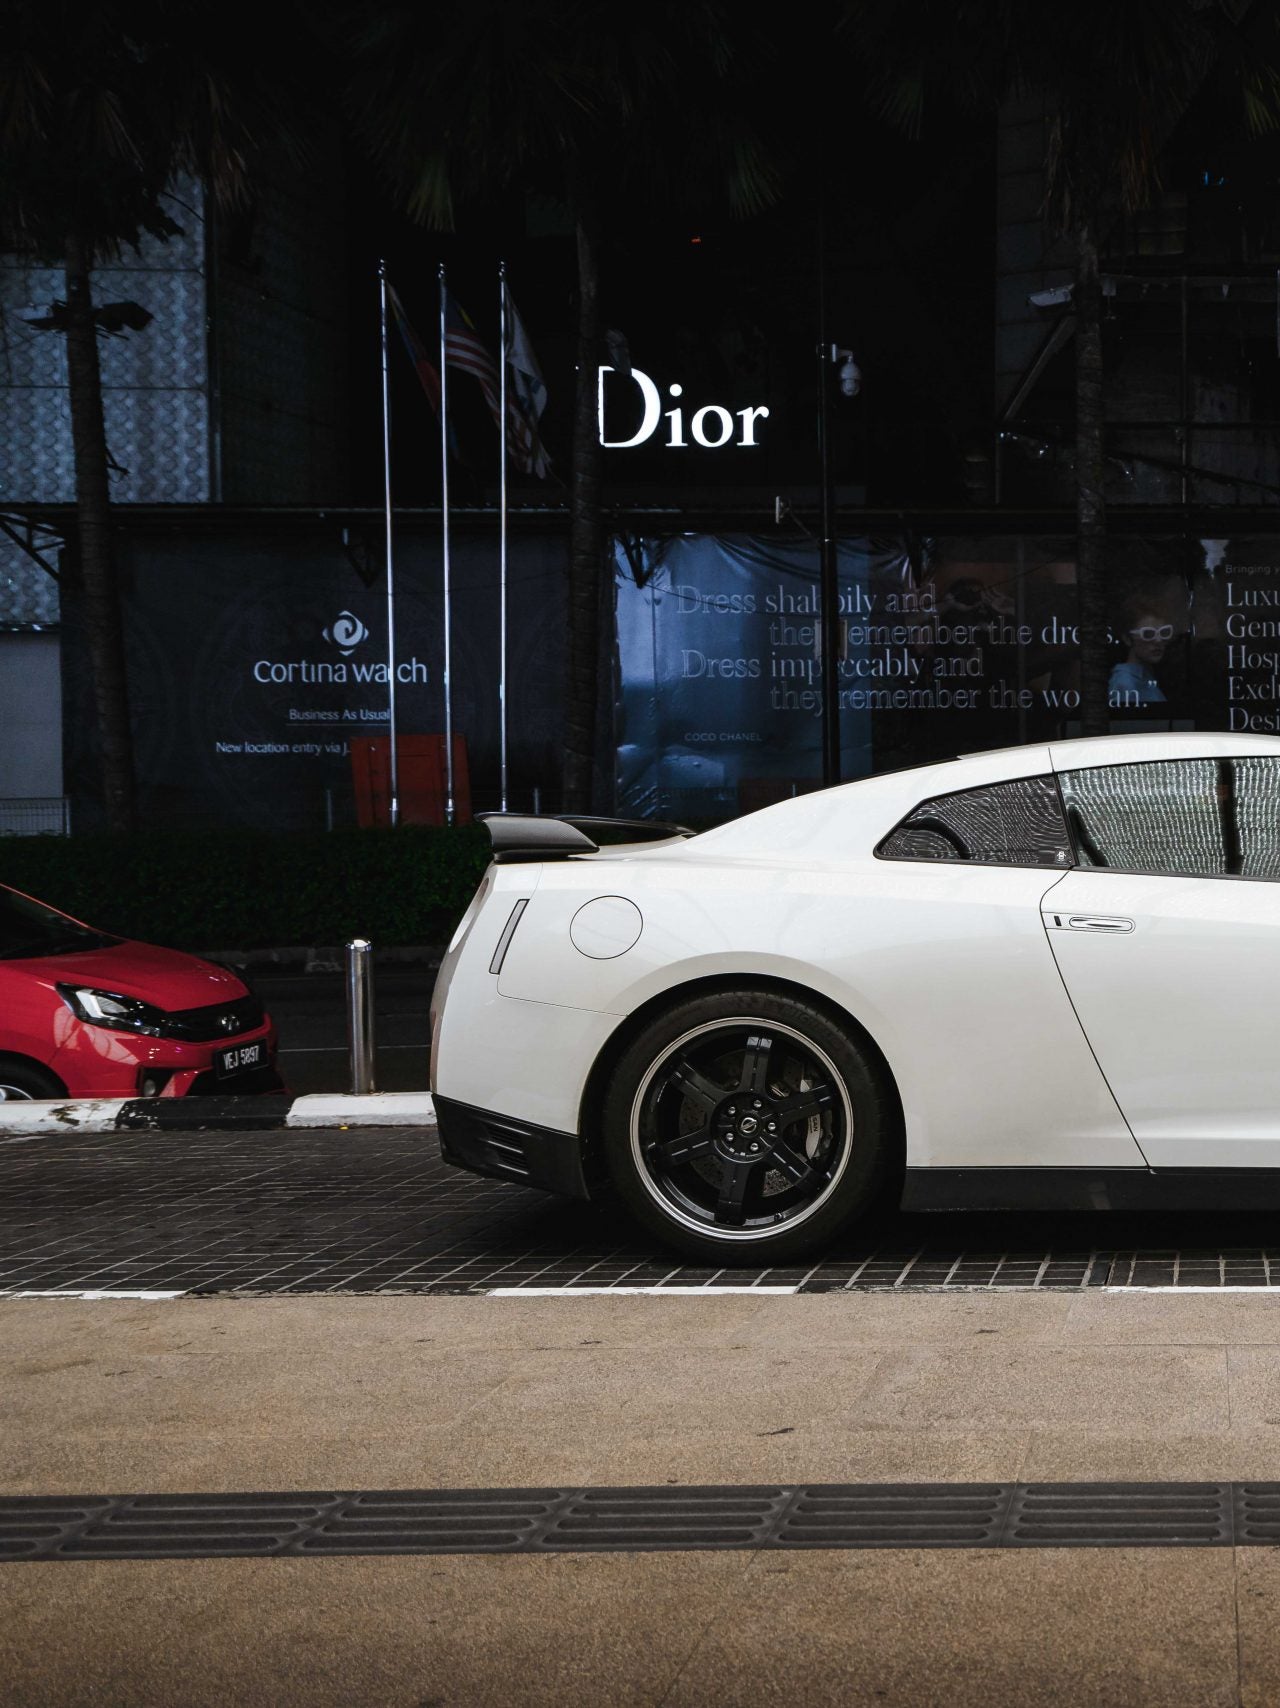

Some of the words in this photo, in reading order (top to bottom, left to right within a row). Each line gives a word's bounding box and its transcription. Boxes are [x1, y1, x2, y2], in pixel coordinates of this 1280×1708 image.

[598, 365, 769, 448] Dior
[1225, 565, 1271, 576] Bringing
[884, 584, 938, 614] and
[988, 616, 1032, 645] the
[253, 659, 347, 683] Cortina
[352, 657, 428, 683] wach
[680, 649, 760, 678] Dress
[933, 648, 984, 677] and
[769, 681, 824, 718] they
[838, 680, 982, 709] remember
[989, 680, 1033, 710] the
[1042, 680, 1157, 710] woan.”
[289, 708, 339, 721] Business
[342, 709, 357, 721] As
[215, 741, 241, 753] New
[244, 741, 289, 753] location
[291, 742, 320, 756] entry
[324, 742, 341, 753] via
[719, 731, 762, 742] CHANEL
